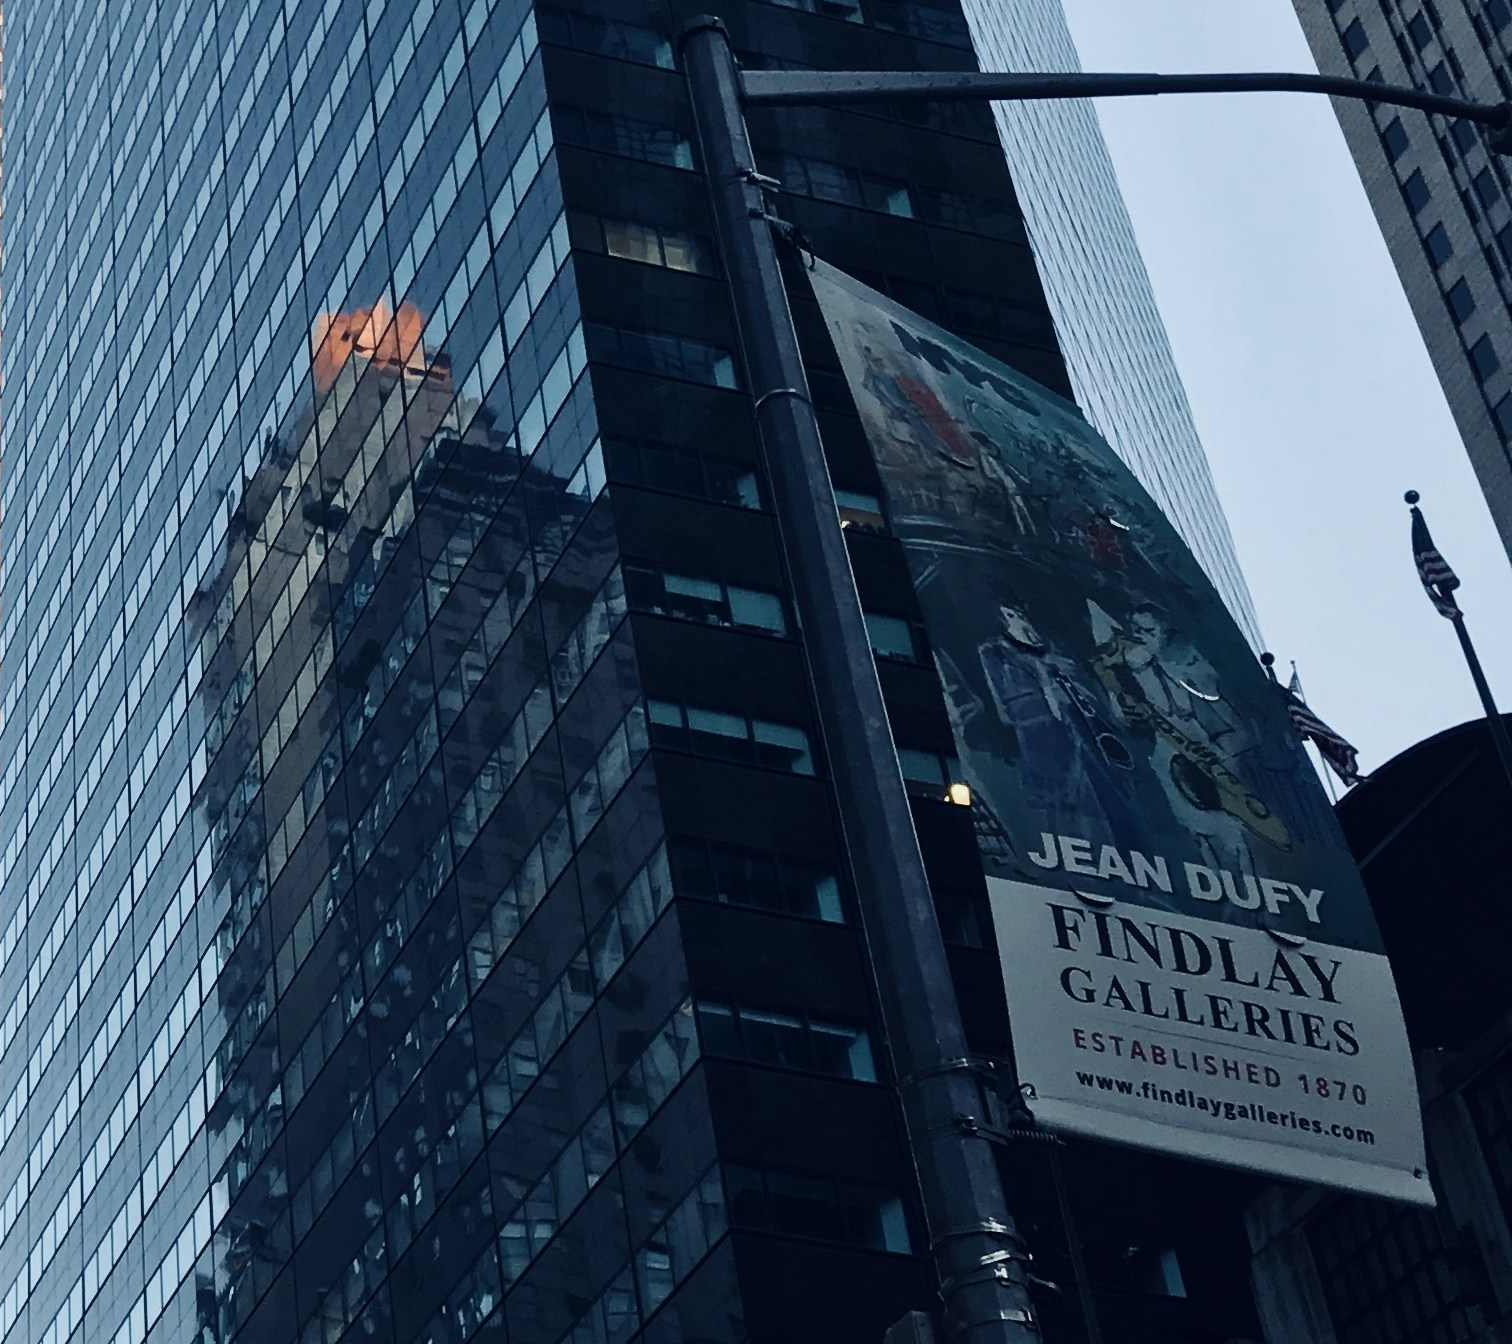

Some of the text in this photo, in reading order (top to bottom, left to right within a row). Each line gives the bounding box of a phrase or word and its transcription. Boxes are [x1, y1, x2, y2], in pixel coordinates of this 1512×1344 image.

[1028, 832, 1326, 924] JEAN DUFY
[1044, 902, 1343, 1005] FINDLAY
[1059, 966, 1361, 1057] GALLERIES
[1072, 1028, 1368, 1106] ESTABLISHED 1870
[1076, 1070, 1375, 1145] www.findlaygalleries.com
